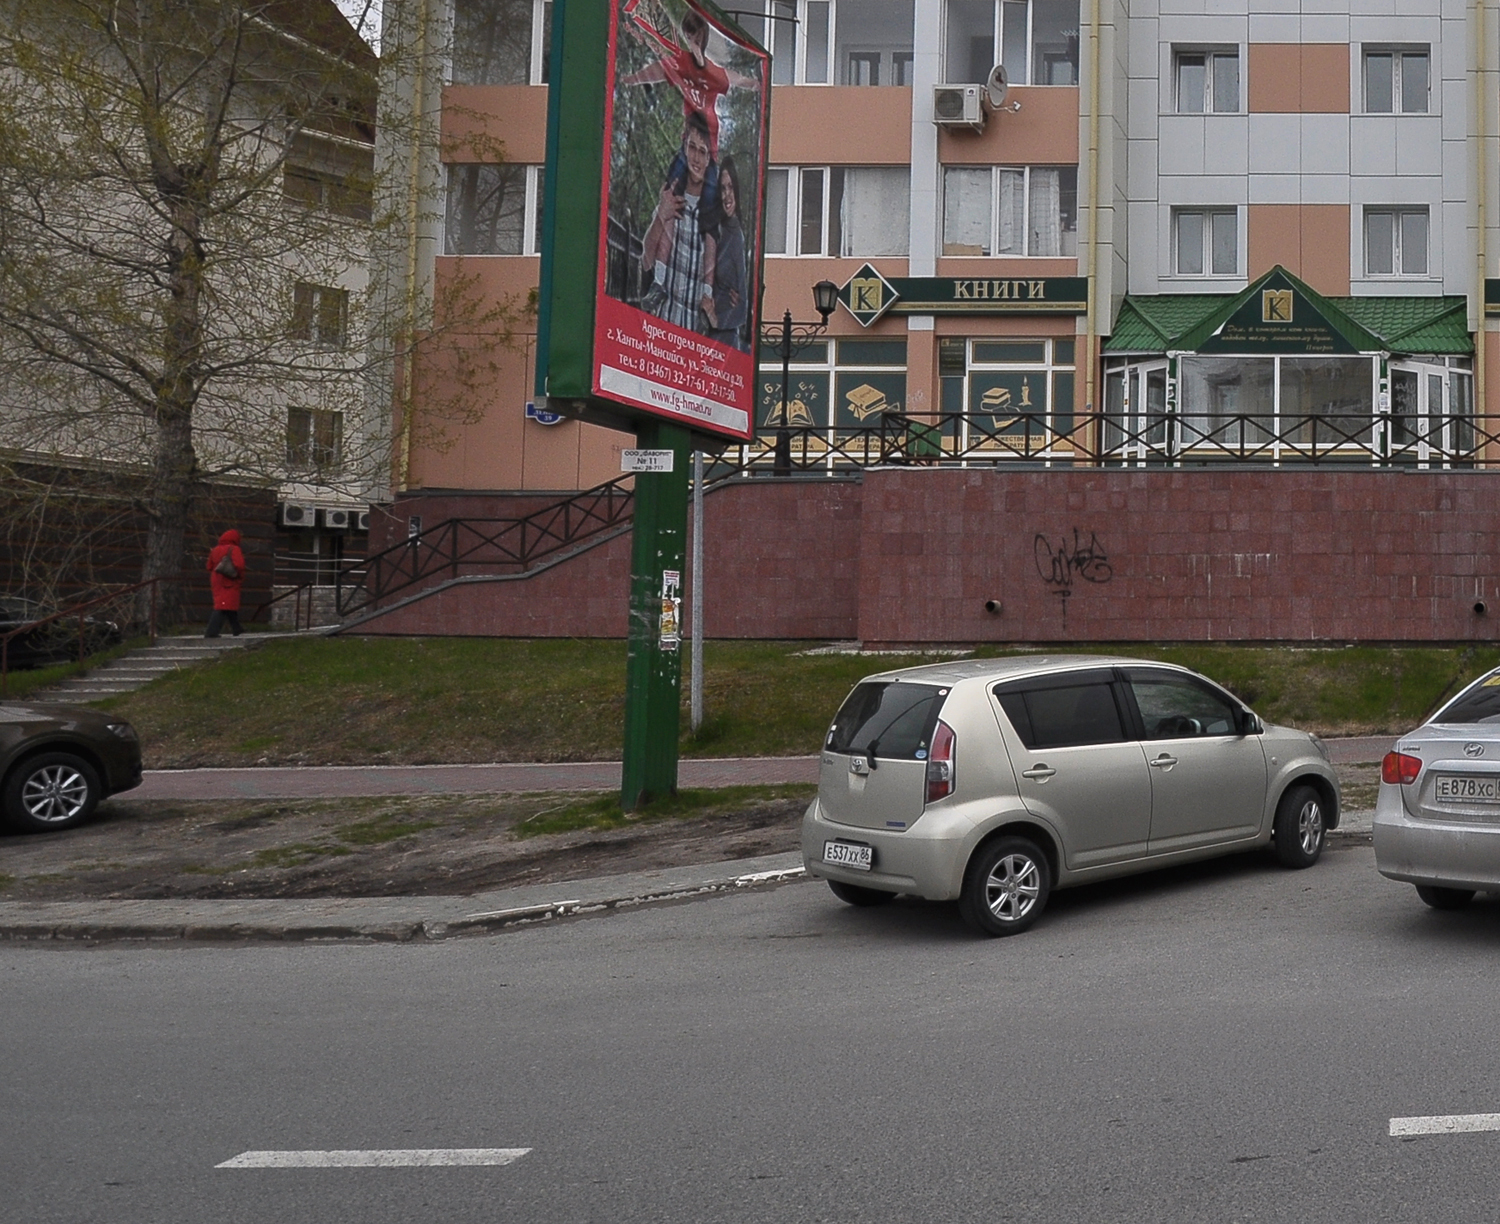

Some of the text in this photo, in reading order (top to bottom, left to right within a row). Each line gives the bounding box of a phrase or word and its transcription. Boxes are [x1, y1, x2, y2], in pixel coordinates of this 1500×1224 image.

[953, 280, 1047, 299] КНИГИ
[642, 319, 667, 340] Адрес
[667, 332, 695, 351] отдела
[606, 328, 615, 340] г.
[615, 328, 687, 369] Ханты-Мансийск,
[688, 359, 699, 372] ул.
[618, 353, 638, 369] тел.:
[639, 358, 646, 372] 8
[646, 361, 672, 381] (3467)
[672, 371, 709, 395] 32-17-61,
[650, 388, 713, 416] www.fg-hmao.ru
[1441, 779, 1494, 797] Е878ХС
[860, 848, 870, 861] 86
